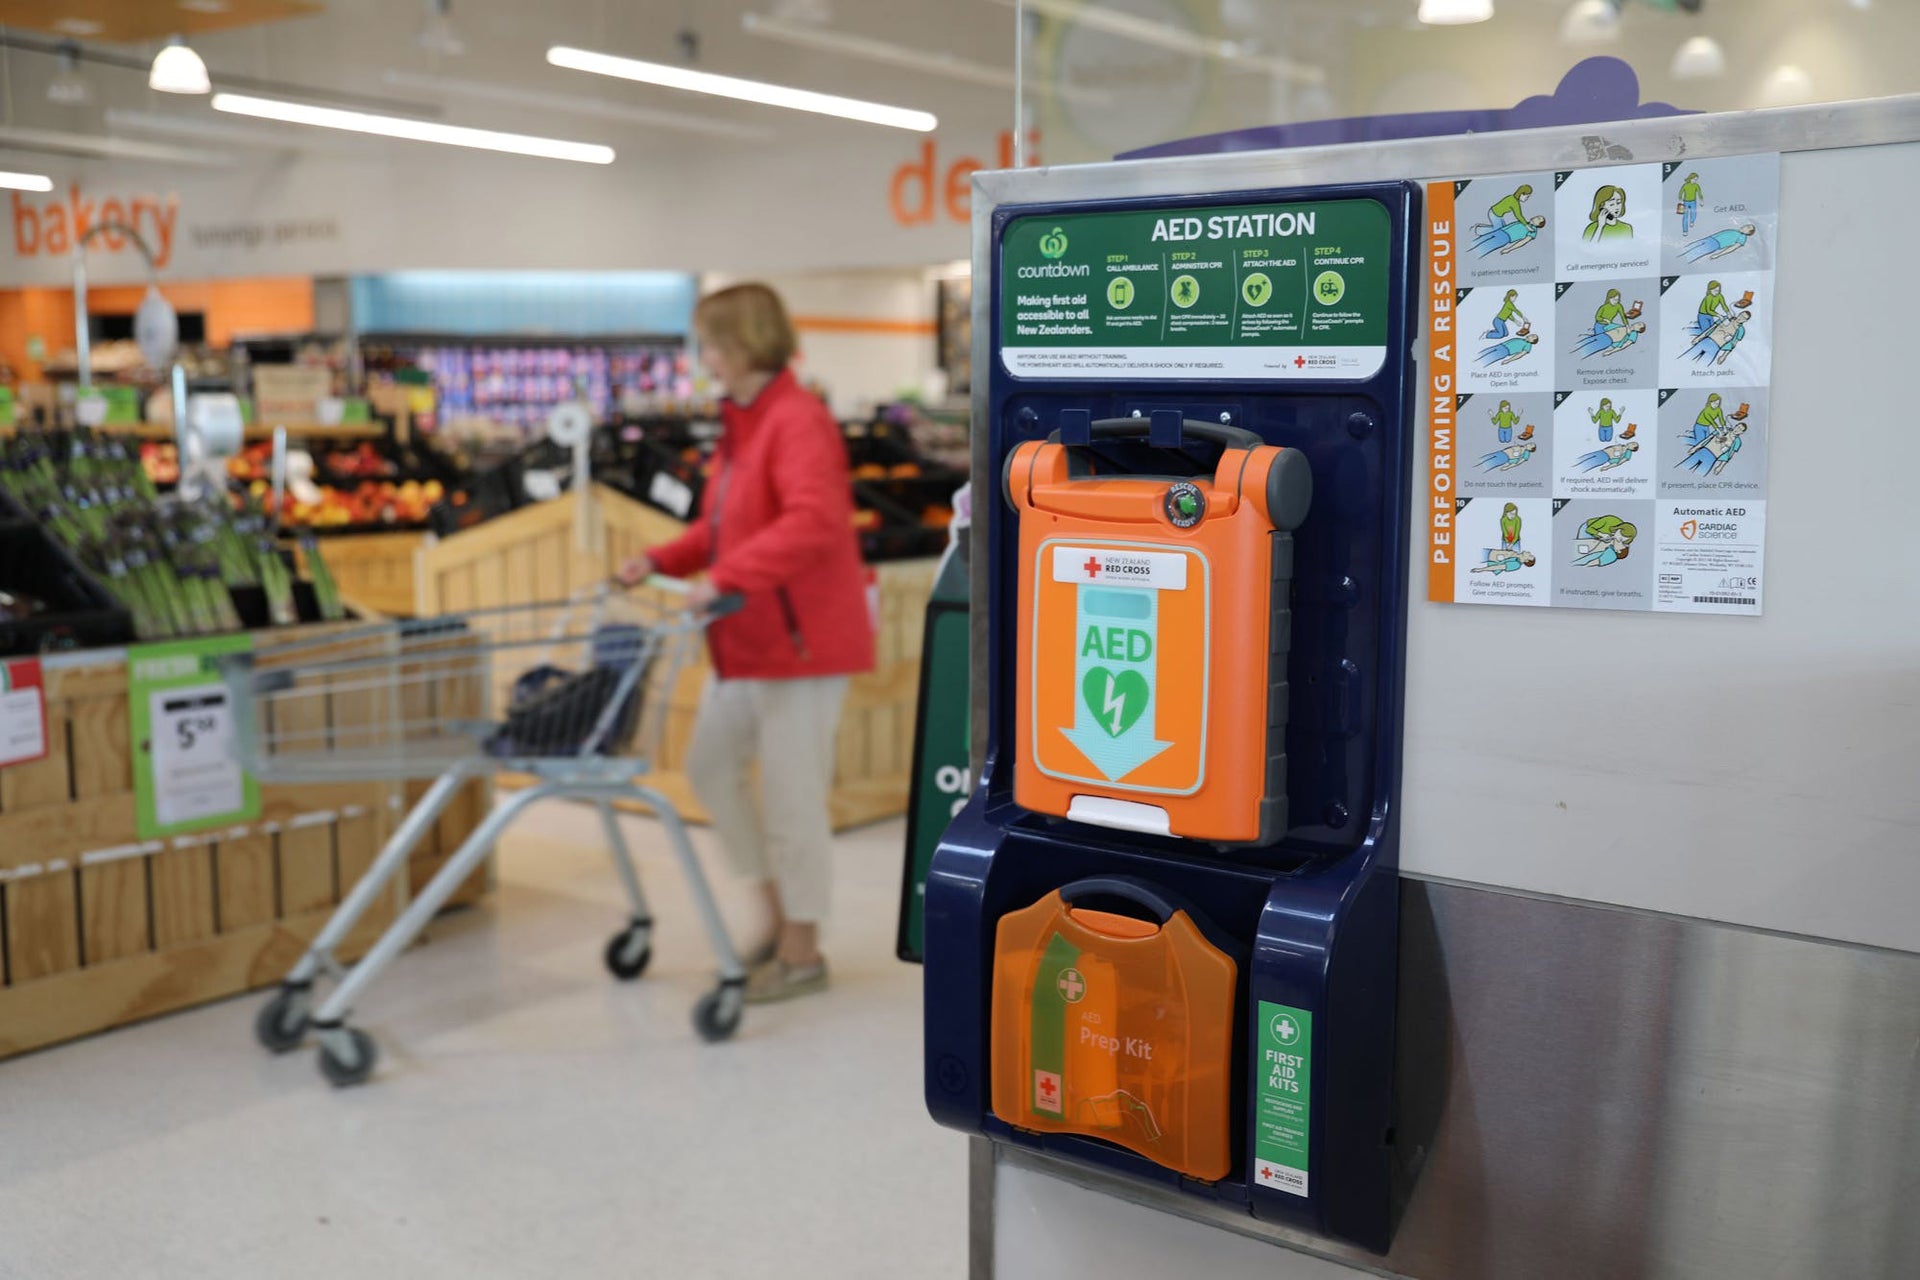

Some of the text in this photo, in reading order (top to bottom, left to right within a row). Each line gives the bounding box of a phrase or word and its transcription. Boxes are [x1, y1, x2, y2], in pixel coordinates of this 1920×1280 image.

[1665, 164, 1671, 173] 3
[1556, 174, 1564, 182] 2
[1456, 182, 1461, 191] 1
[1713, 205, 1727, 213] Get
[11, 184, 179, 269] bakery
[1151, 212, 1316, 242] AED STATION
[1243, 250, 1263, 258] STEP
[1314, 247, 1335, 256] STEP
[1106, 255, 1125, 263] STEP
[1171, 252, 1196, 261] STEP 2
[1171, 261, 1223, 270] ADMINISTER CPR
[1243, 260, 1270, 268] ATTACH
[1283, 259, 1297, 267] AED
[1314, 257, 1349, 266] CONTINUE
[1580, 262, 1618, 271] emergency
[1619, 260, 1649, 268] services!
[1017, 261, 1090, 278] countdown
[1121, 263, 1159, 272] AMBULANCE
[1477, 268, 1500, 277] patient
[1501, 266, 1540, 276] responsive?
[1662, 279, 1669, 287] 6
[1457, 290, 1464, 298] 4
[1017, 294, 1087, 308] Making first aid
[1017, 309, 1089, 320] accessible to all
[1017, 324, 1093, 335] New Zealanders.
[1513, 371, 1540, 379] ground.
[1605, 368, 1635, 376] clothing.
[1716, 369, 1736, 377] pads.
[1433, 220, 1451, 564] PERFORMING A RESCUE
[1660, 391, 1667, 399] 9
[1457, 395, 1464, 403] 7
[1171, 482, 1197, 495] RESCUE
[1667, 482, 1696, 490] present,
[1697, 482, 1717, 490] place
[1553, 500, 1561, 508] 11
[1673, 507, 1746, 517] Automatic AED
[1698, 523, 1737, 531] CARDIAC
[1698, 531, 1737, 539] science
[1121, 558, 1151, 566] ZEALAND
[1106, 564, 1151, 575] RED CROSS
[1472, 588, 1487, 596] Give
[1616, 590, 1644, 598] breaths.
[1081, 625, 1153, 663] AED
[1081, 1011, 1101, 1024] AED
[1080, 1026, 1152, 1060] Prep Kit
[1265, 1049, 1304, 1068] FIRST
[1272, 1064, 1296, 1079] AID
[1269, 1075, 1299, 1093] KITS
[1274, 1173, 1285, 1181] RED
[1285, 1176, 1303, 1186] CROSS
